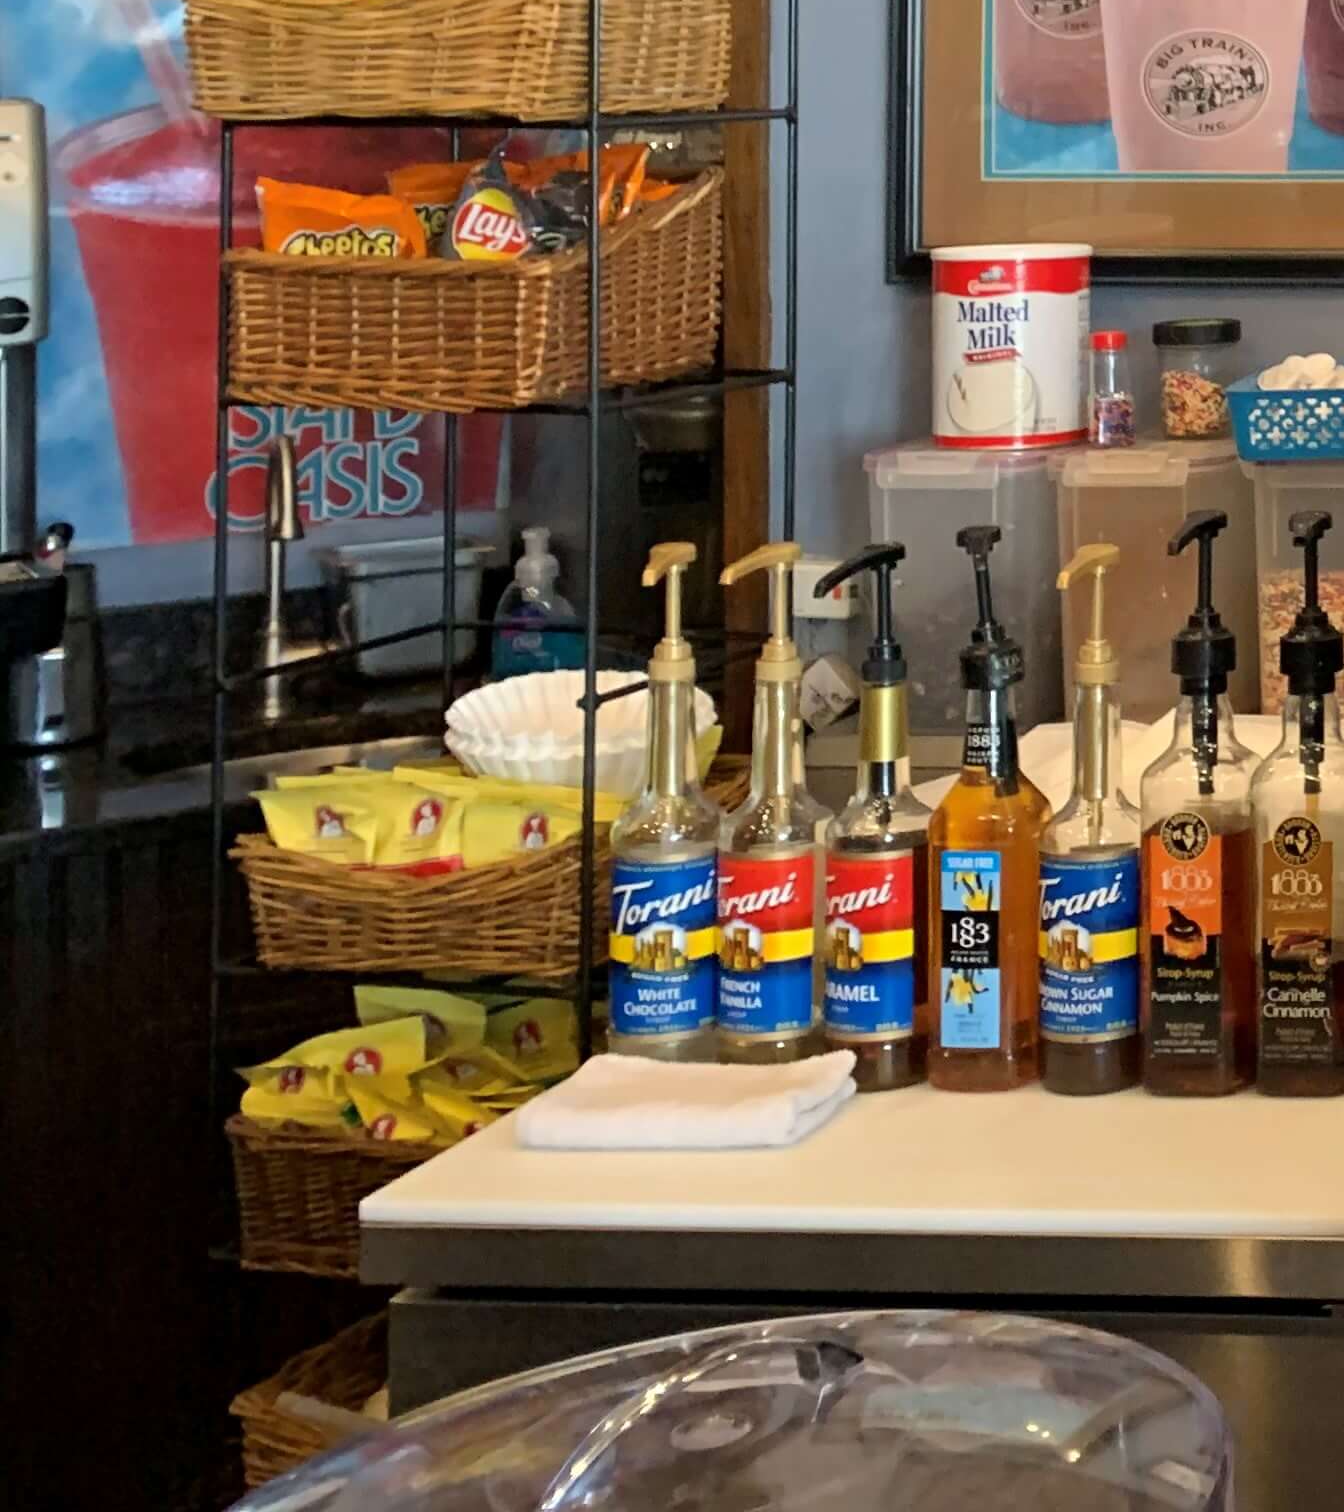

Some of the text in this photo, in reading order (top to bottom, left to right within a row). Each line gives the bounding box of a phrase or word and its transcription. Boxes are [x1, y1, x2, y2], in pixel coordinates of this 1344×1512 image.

[1155, 36, 1250, 70] BIG TRAIN
[957, 299, 1030, 323] Malted
[966, 324, 1017, 350] Milk
[612, 869, 716, 936] Torani
[826, 872, 895, 916] rani
[637, 987, 682, 1002] WHITE
[826, 982, 881, 1002] RAMEL
[1070, 986, 1114, 1002] SUGAR
[1151, 990, 1220, 1004] Pumpkin Spice
[623, 998, 698, 1018] CHOCOLATE
[1262, 1003, 1331, 1019] Cinnamon
